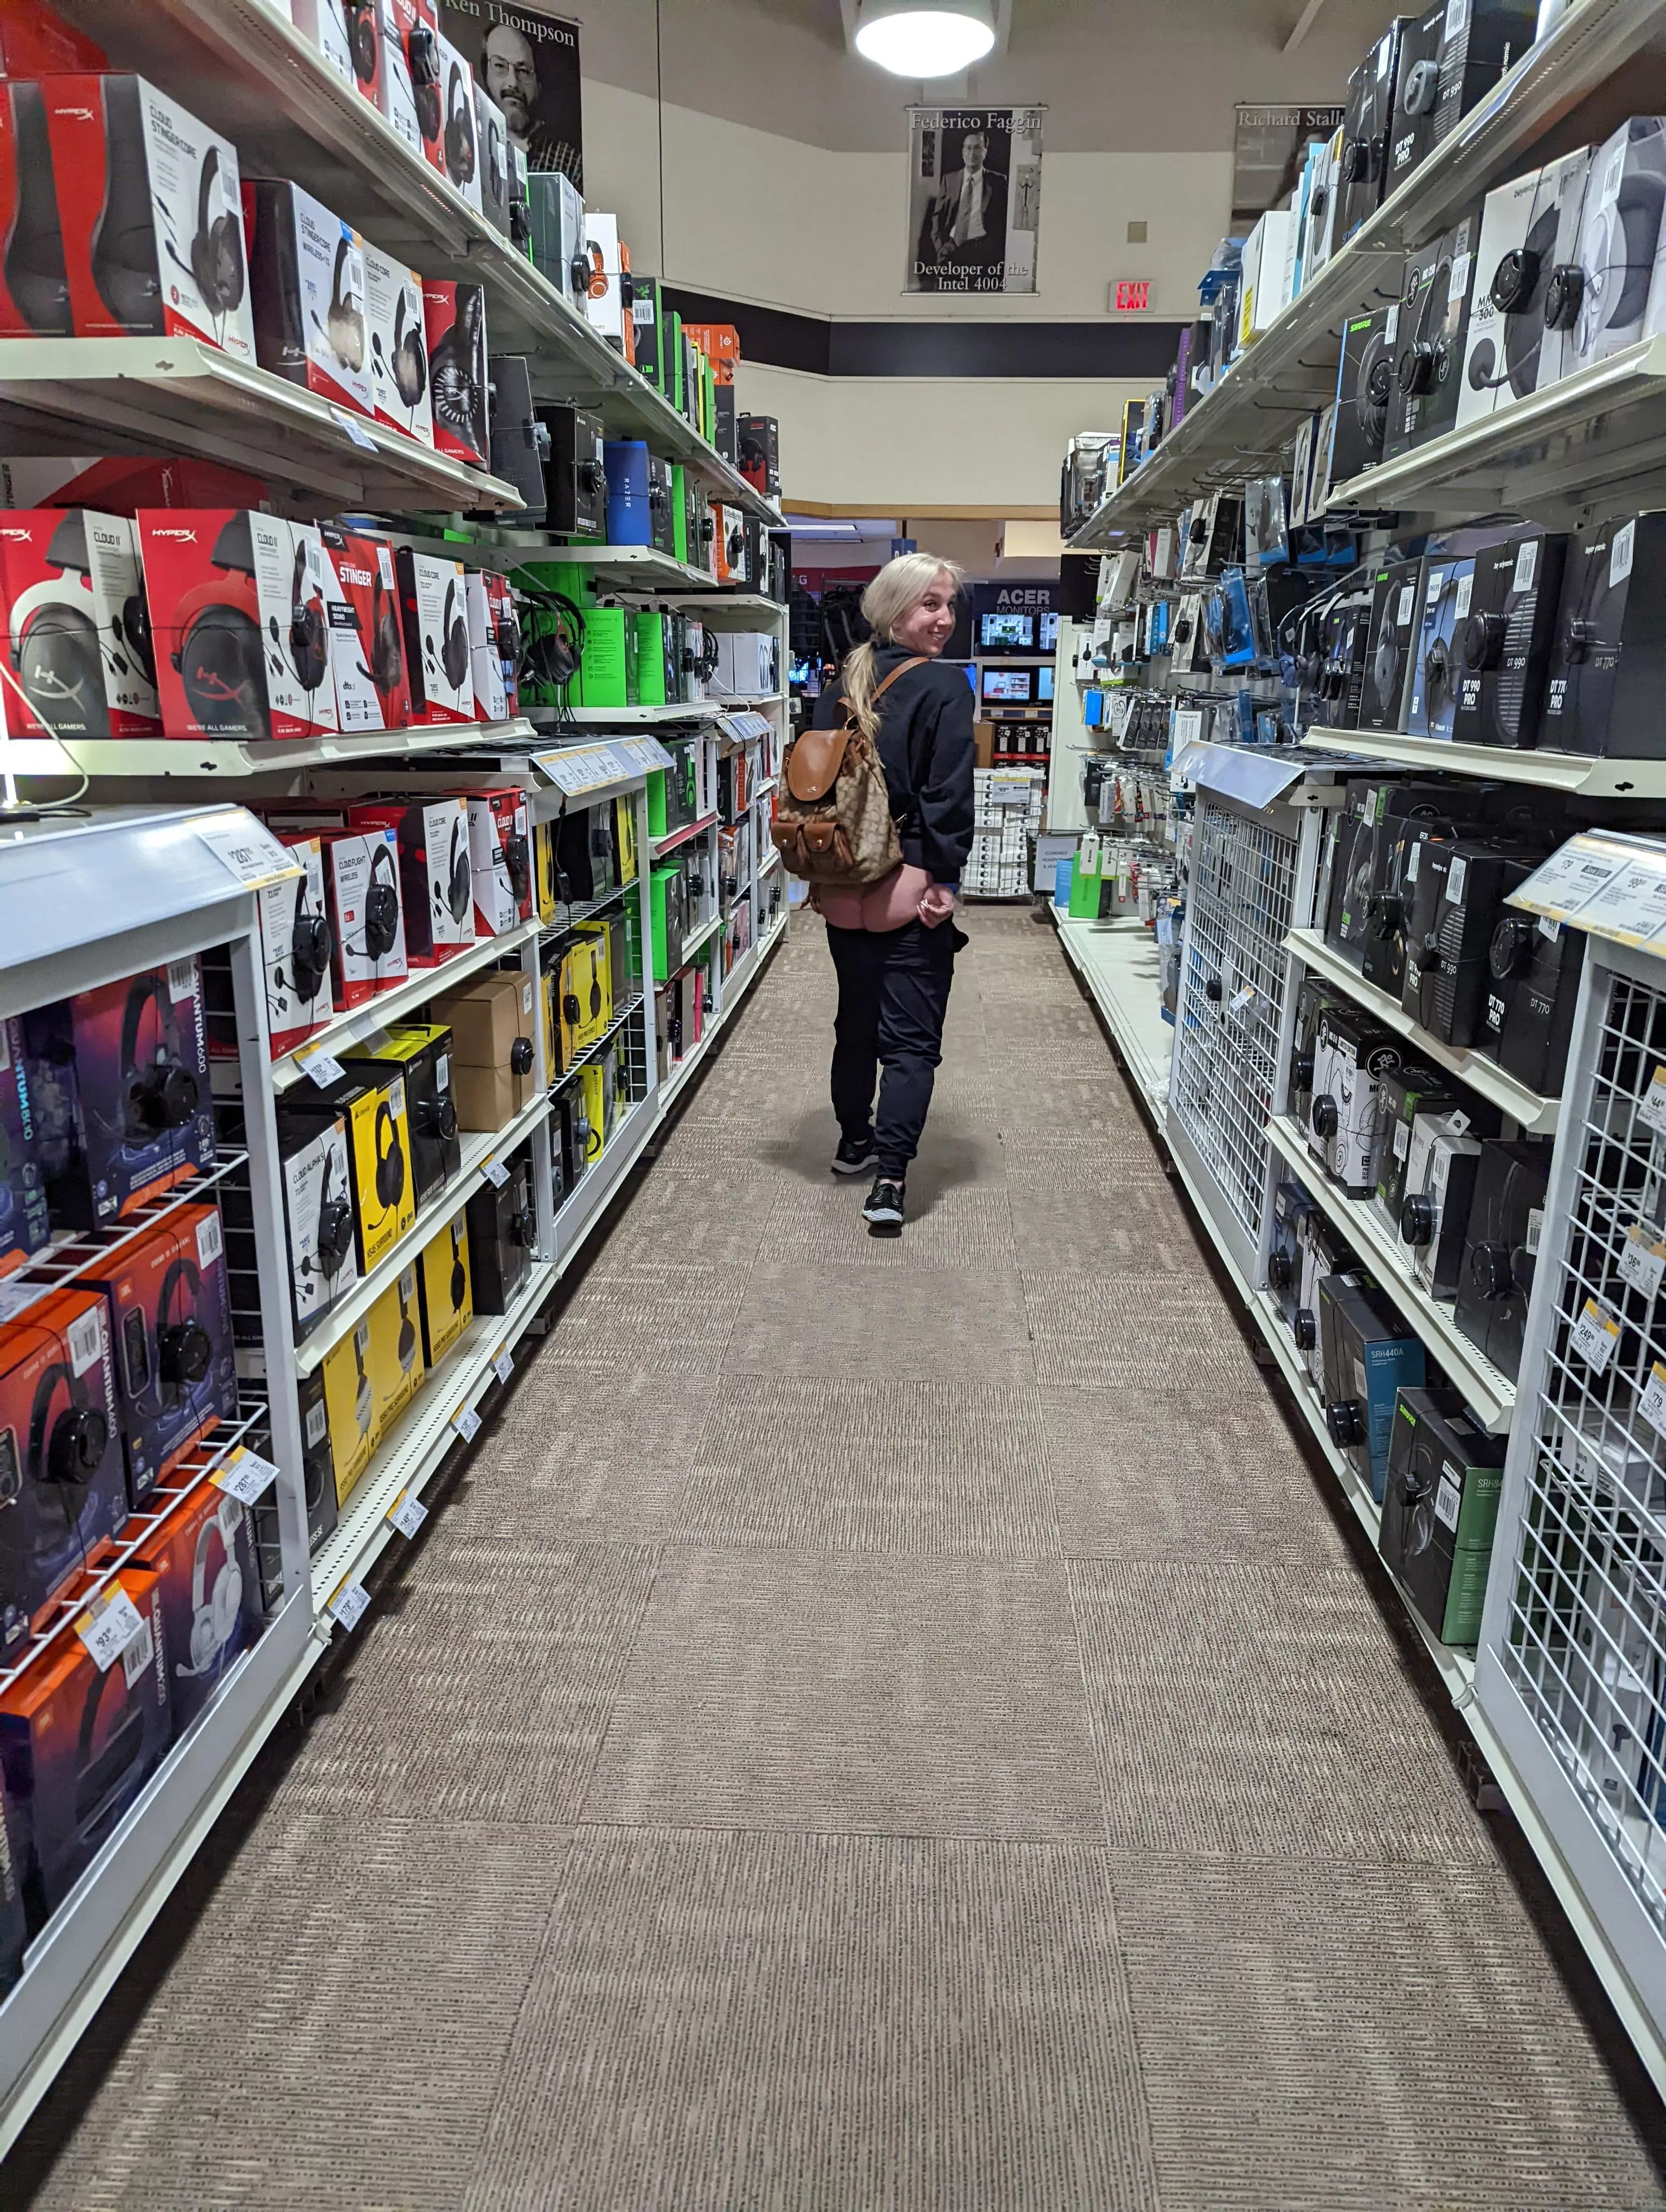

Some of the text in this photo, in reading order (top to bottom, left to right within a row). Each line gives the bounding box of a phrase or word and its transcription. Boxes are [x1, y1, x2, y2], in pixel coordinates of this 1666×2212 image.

[489, 3, 576, 48] Thompson
[1450, 81, 1462, 98] 990
[912, 113, 1042, 134] Federico Faggin
[1239, 111, 1300, 126] Richard
[1395, 132, 1414, 155] DT 990
[1397, 149, 1410, 164] PRO
[914, 261, 1029, 276] Developer of the
[938, 277, 1007, 291] Intel 4004
[1117, 282, 1150, 310] EXIT
[1479, 306, 1495, 321] 300
[1349, 319, 1372, 333] SHURE
[94, 531, 115, 545] CLOUD
[152, 529, 198, 543] HYPERX
[257, 533, 274, 546] CLOUD
[339, 566, 373, 587] STINGER
[997, 589, 1050, 605] ACER
[996, 606, 1050, 614] MONITORS
[1507, 657, 1526, 669] DT 990
[1595, 657, 1614, 670] DT 770
[1463, 679, 1481, 692] DT 990
[1549, 679, 1558, 693] DT
[1463, 693, 1476, 705] PRO
[1550, 695, 1562, 709] PRO
[339, 859, 353, 870] CLOUD
[1441, 960, 1457, 975] DT 990
[1409, 973, 1418, 987] PRO
[1488, 993, 1505, 1015] DT 770
[1530, 998, 1550, 1014] DT 770
[1489, 1008, 1500, 1026] PRO
[293, 1167, 307, 1184] CLOUD
[307, 1156, 321, 1172] ALPHA
[1371, 1348, 1404, 1359] SRH440A
[1399, 1404, 1416, 1427] SHURE
[1477, 1478, 1502, 1488] SRH8
